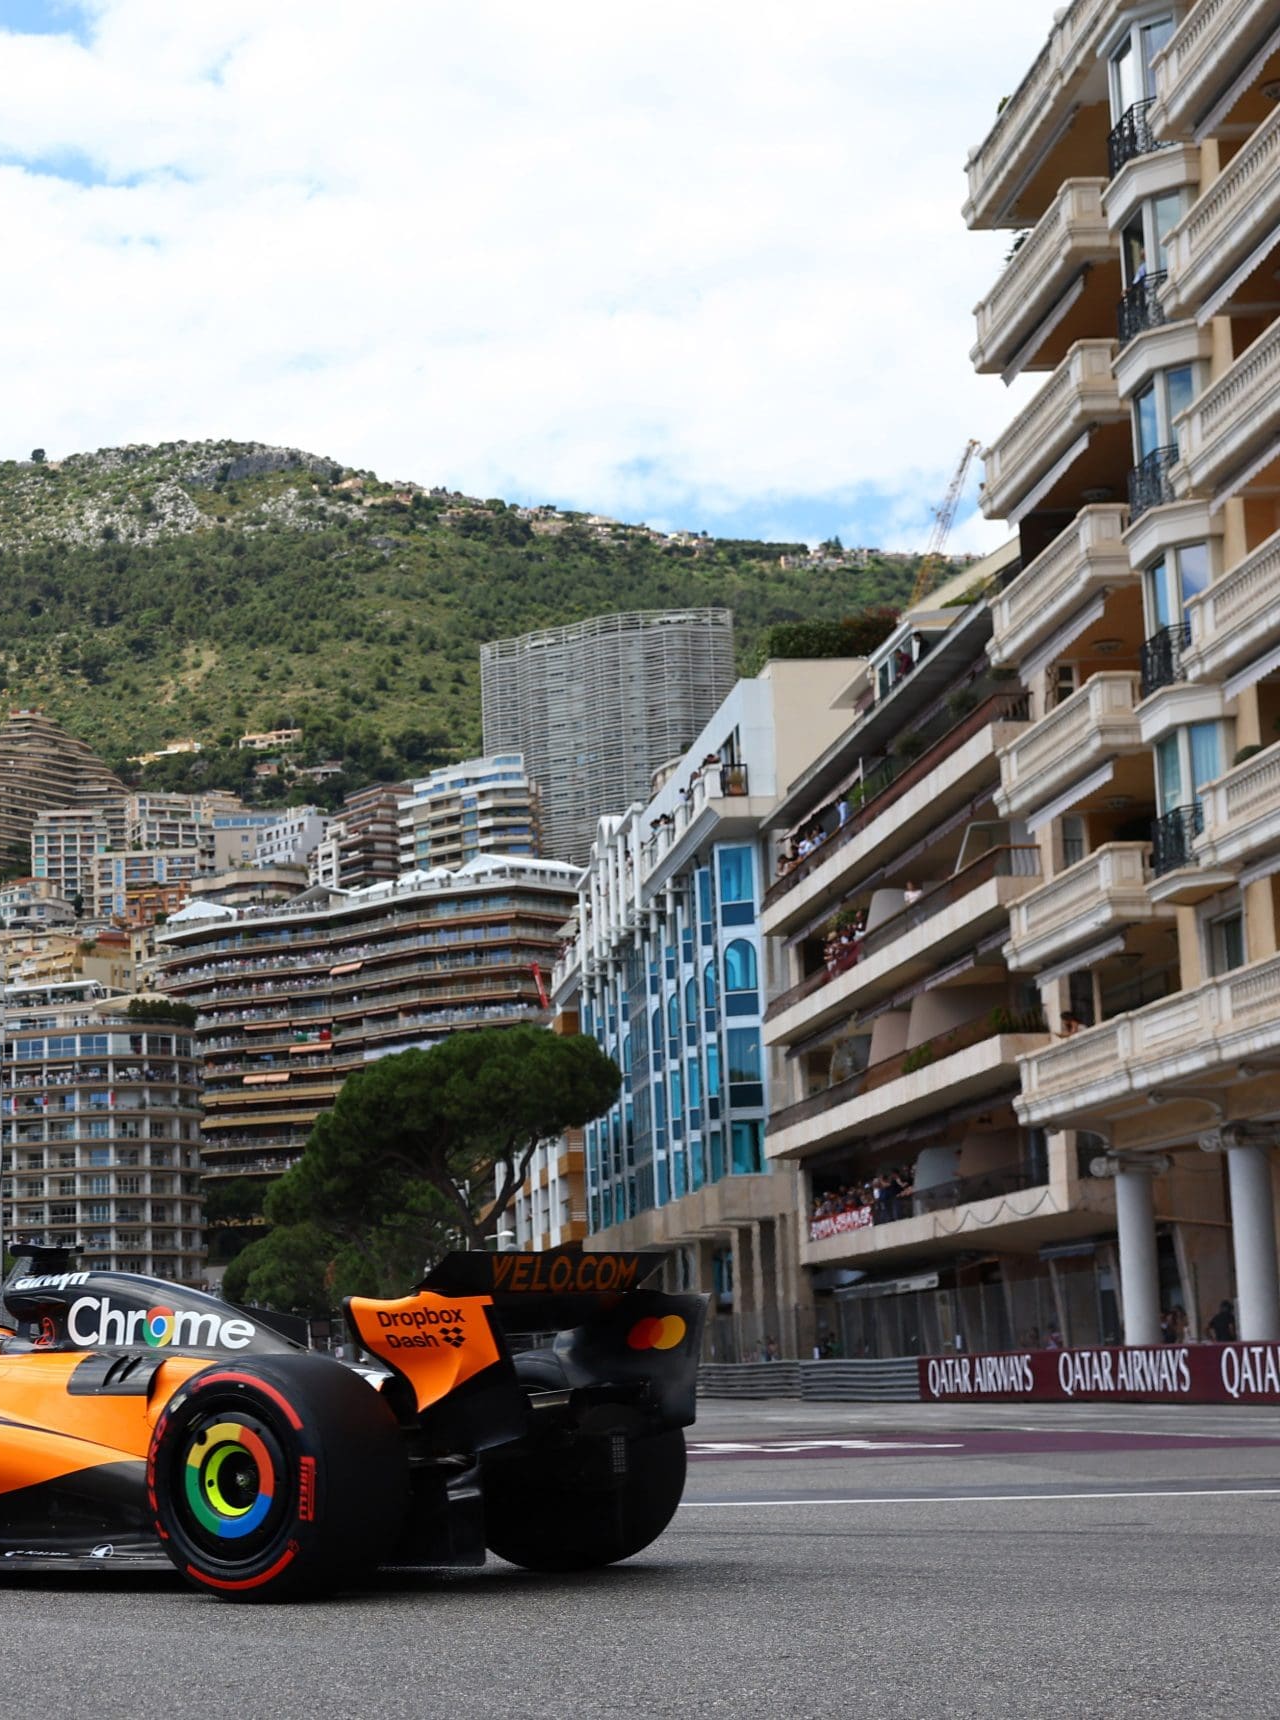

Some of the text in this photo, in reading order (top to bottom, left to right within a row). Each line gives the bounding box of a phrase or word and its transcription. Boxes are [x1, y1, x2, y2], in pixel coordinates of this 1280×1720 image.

[492, 1255, 639, 1292] VELO.COM
[67, 1296, 256, 1350] Chrome
[377, 1308, 466, 1329] Dropbox
[384, 1330, 441, 1349] Dash
[927, 1354, 1034, 1397] QATAR AIRWAYS
[1057, 1348, 1191, 1396] QATAR AIRWAYS
[1221, 1345, 1280, 1398] QATA
